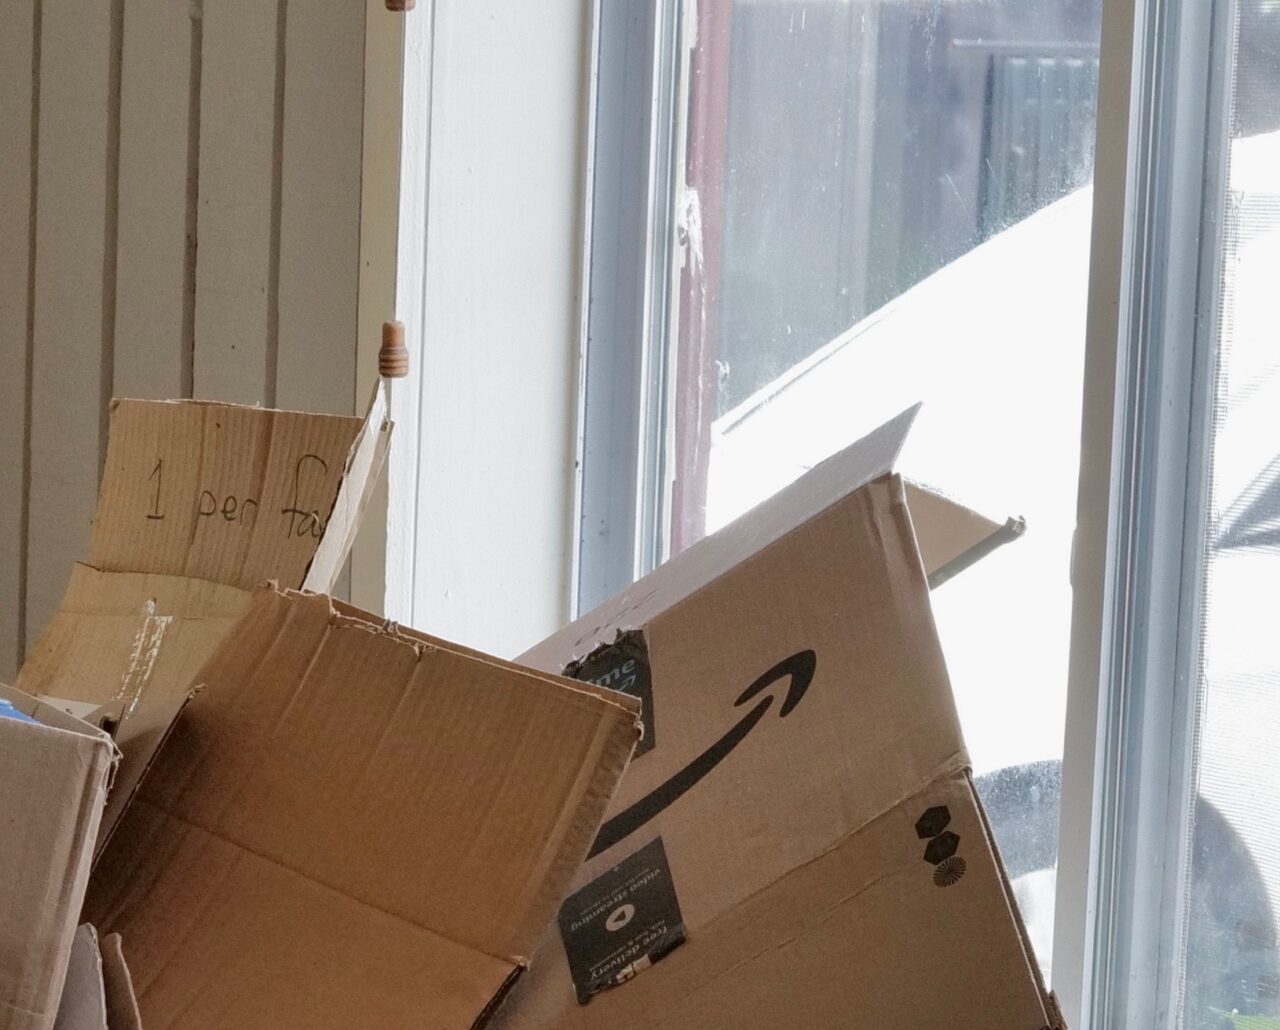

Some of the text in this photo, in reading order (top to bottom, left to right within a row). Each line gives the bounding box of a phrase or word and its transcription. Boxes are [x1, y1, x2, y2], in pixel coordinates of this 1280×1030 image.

[146, 458, 165, 520] 1
[191, 490, 259, 545] per
[629, 868, 662, 891] video
[571, 890, 628, 932] streaming
[591, 944, 640, 980] delivery
